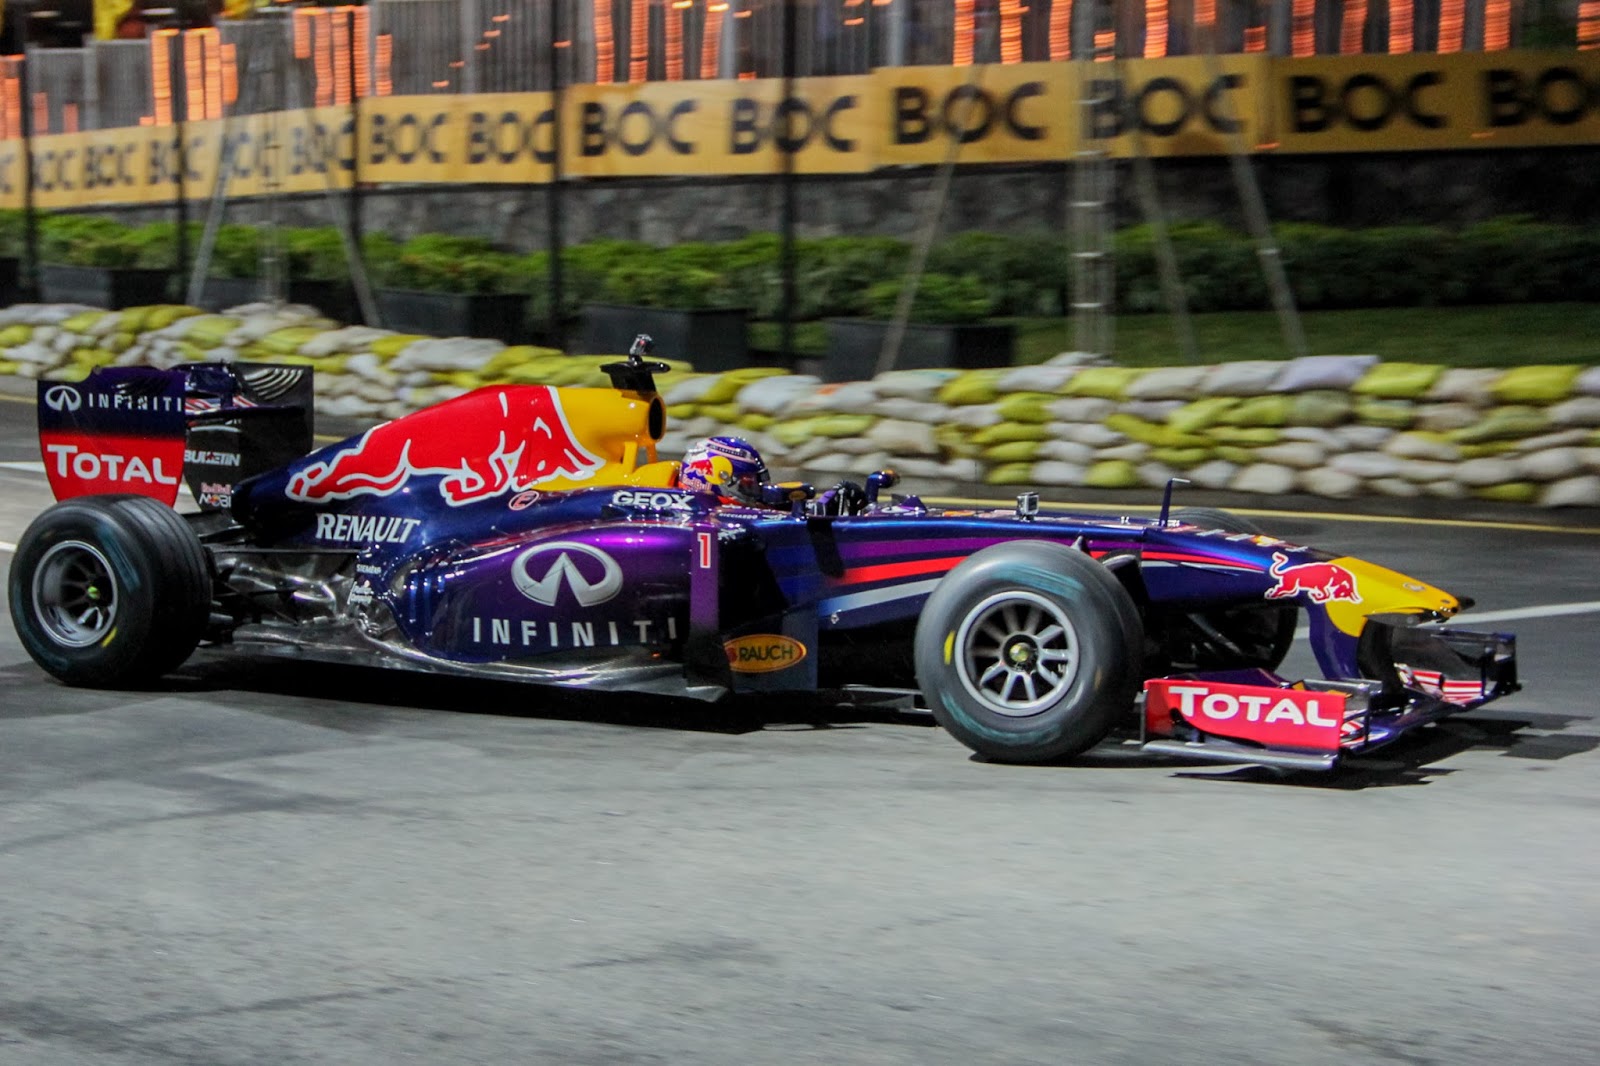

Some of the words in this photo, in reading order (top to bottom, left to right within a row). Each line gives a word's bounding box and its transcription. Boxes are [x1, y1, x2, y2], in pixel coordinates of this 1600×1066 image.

[891, 82, 1049, 146] BOC
[1082, 74, 1247, 140] BOC
[1289, 71, 1451, 135] BOC
[1482, 65, 1600, 130] BO
[369, 111, 449, 165] BOC
[467, 109, 555, 165] BOC
[578, 98, 697, 158] BOC
[729, 95, 858, 155] BOC
[88, 392, 182, 412] INFINITI
[47, 444, 178, 485] TOTAL
[612, 490, 695, 511] GEOX
[315, 513, 421, 543] RENAULT
[697, 532, 711, 569] 1
[473, 617, 678, 647] INFINITI
[739, 644, 794, 661] RAUCH
[1168, 686, 1338, 728] TOTAL
